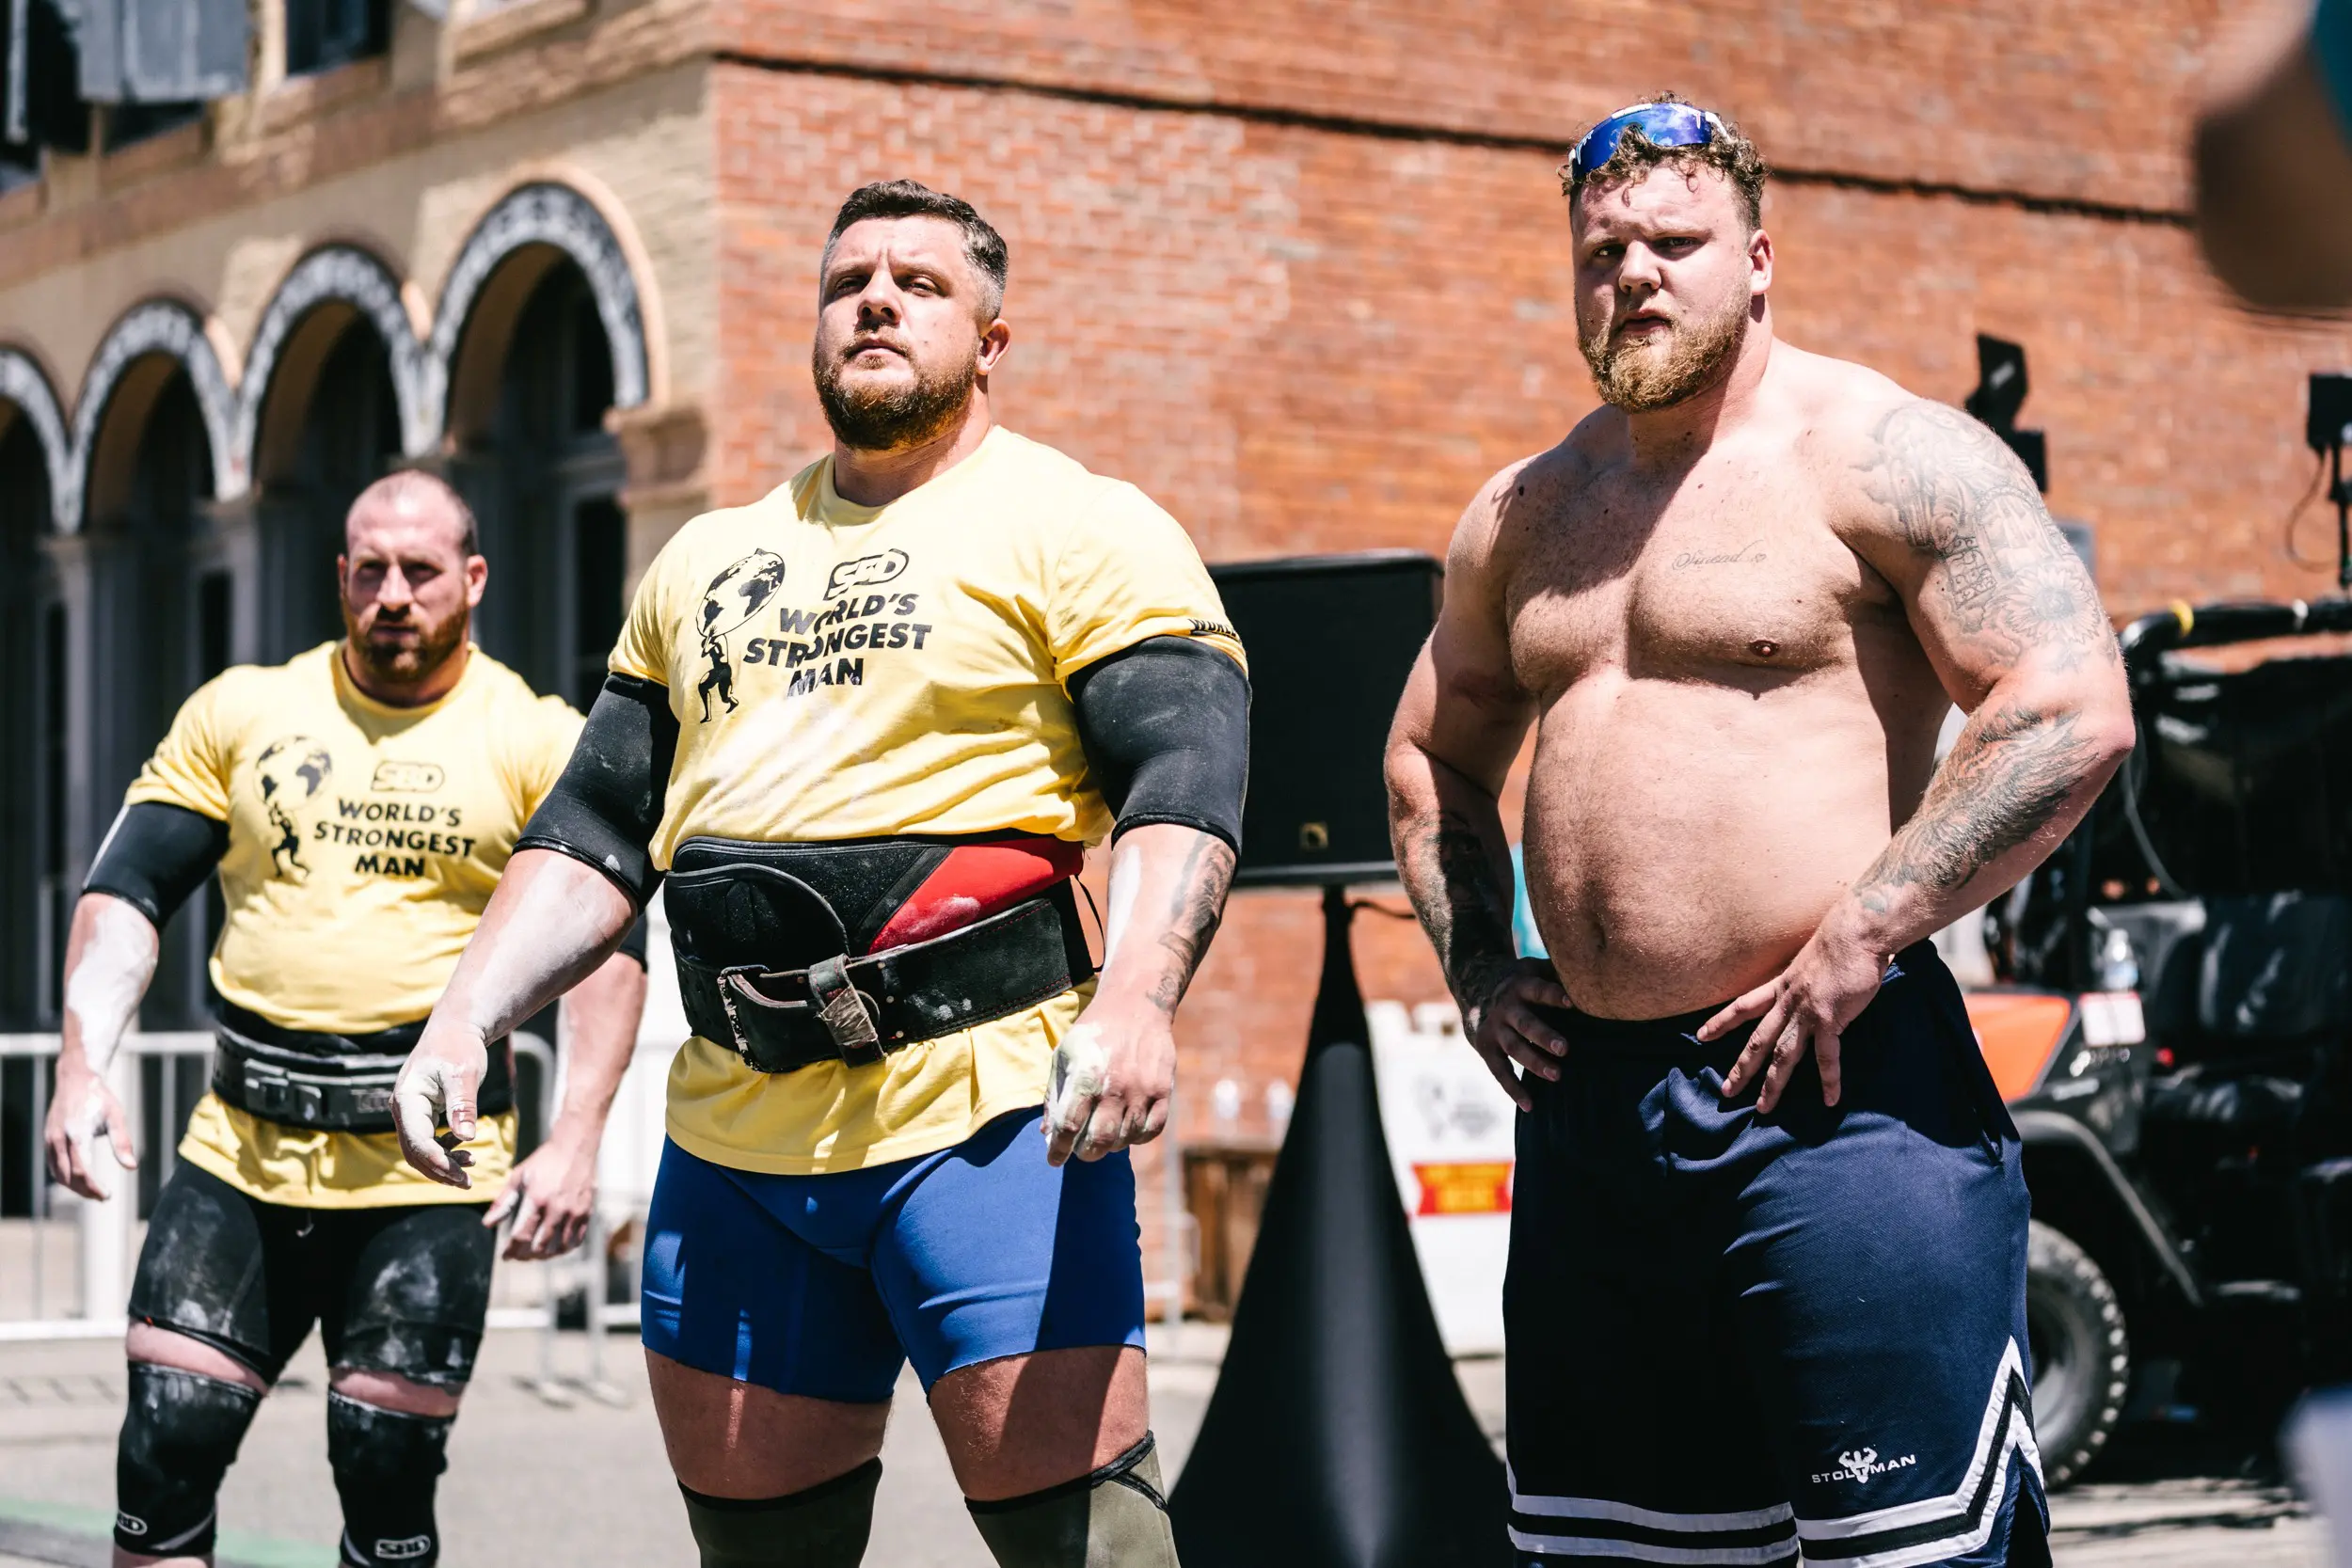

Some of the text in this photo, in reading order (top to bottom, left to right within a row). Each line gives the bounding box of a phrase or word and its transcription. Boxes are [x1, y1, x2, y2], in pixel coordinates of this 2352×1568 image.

[780, 593, 920, 636] WORLD'S
[742, 623, 932, 669] STRONGEST
[787, 657, 865, 698] MAN
[338, 798, 463, 828] WORLD'S
[313, 820, 477, 858] STRONGEST
[354, 854, 425, 878] MAN
